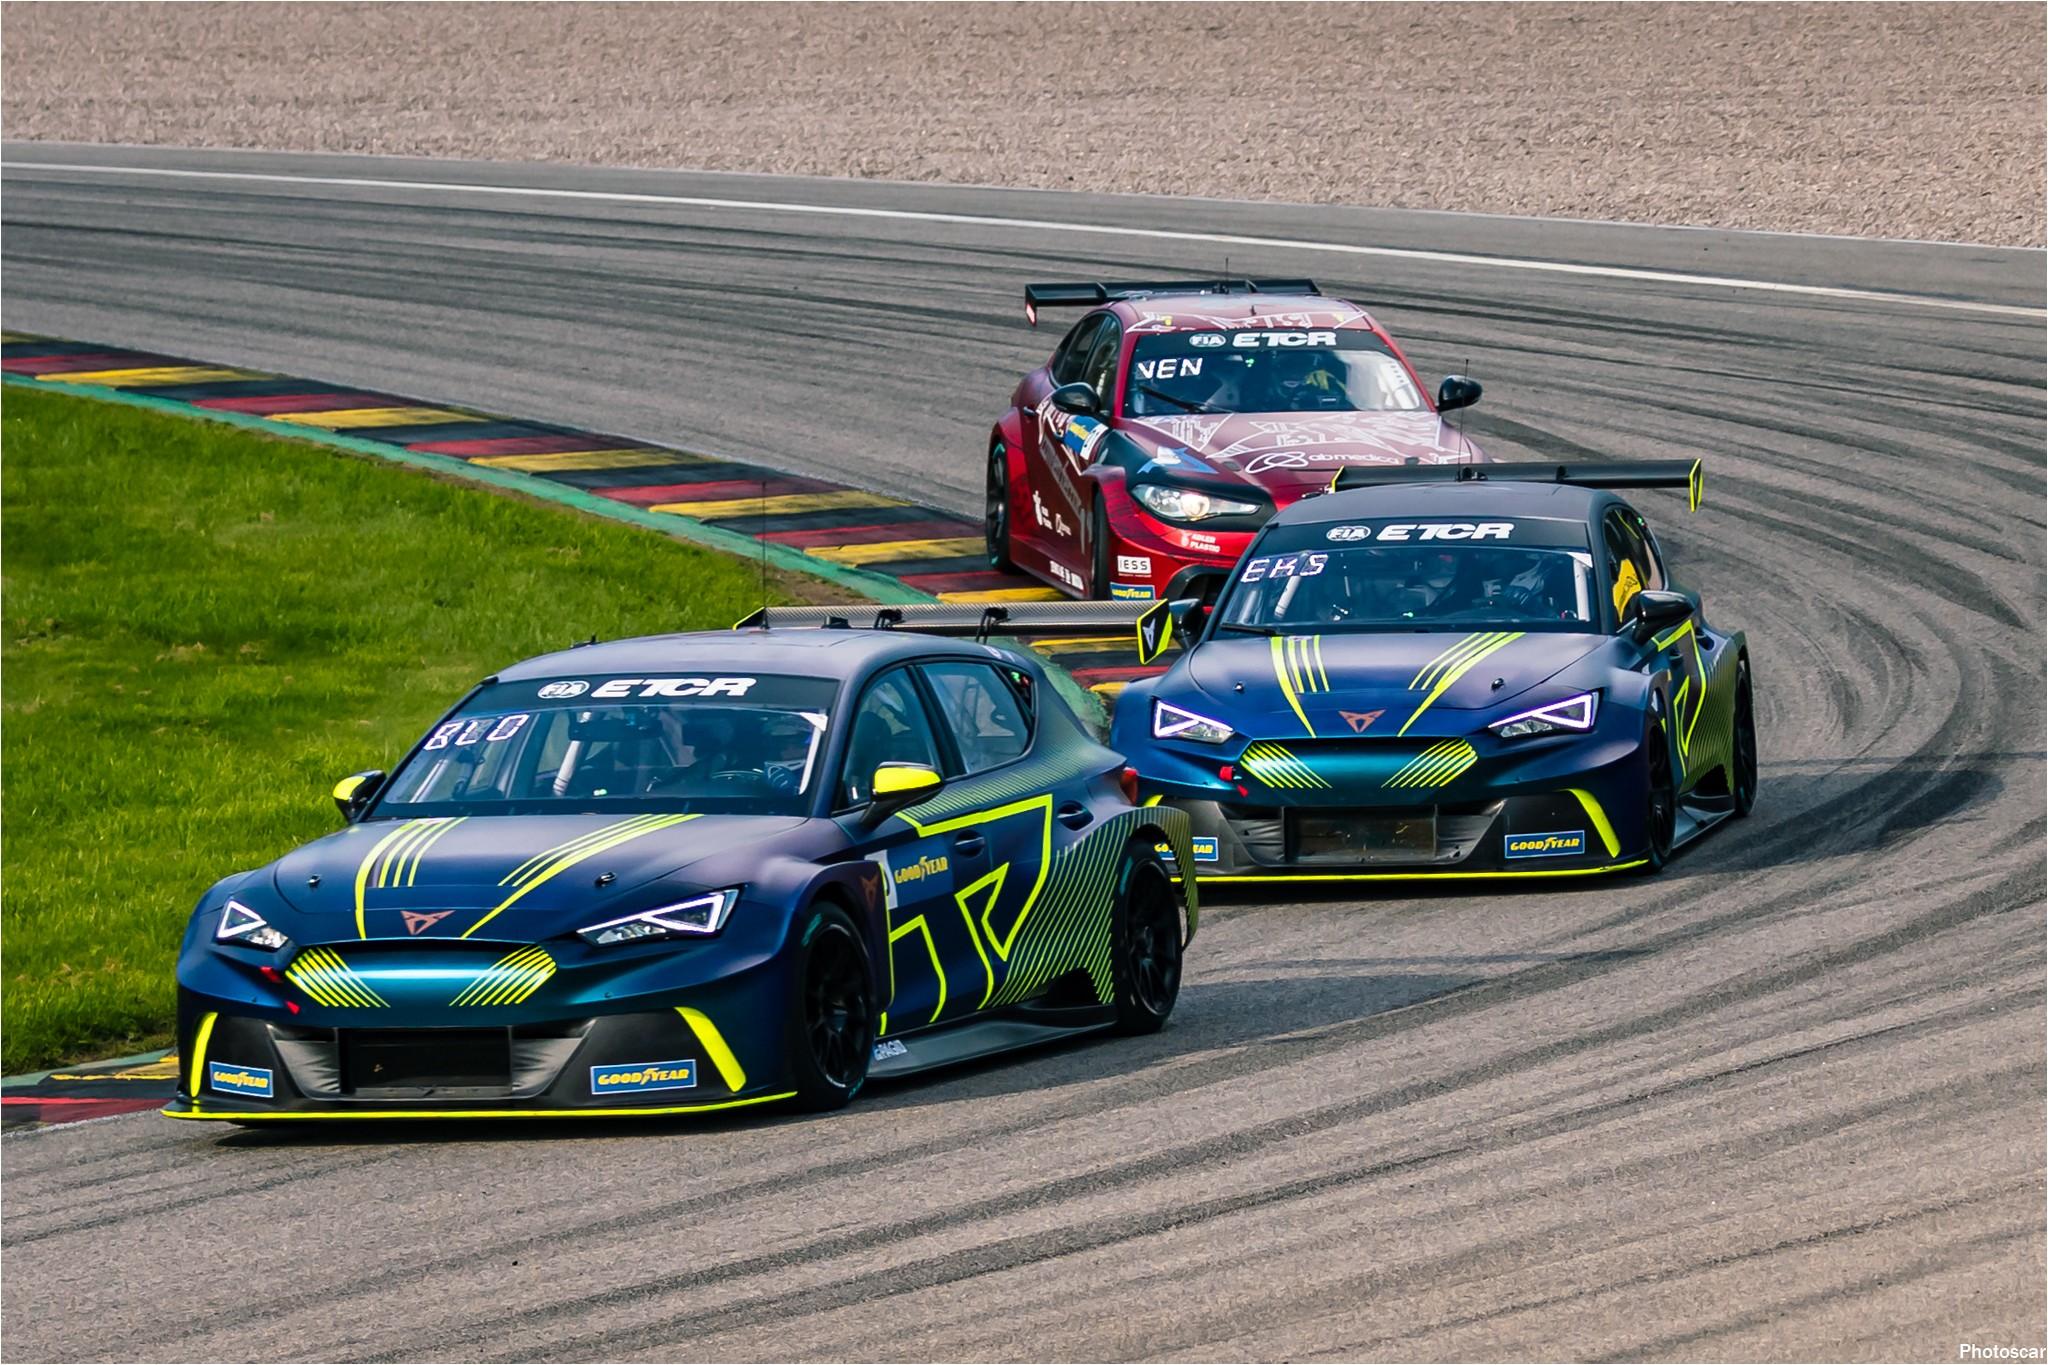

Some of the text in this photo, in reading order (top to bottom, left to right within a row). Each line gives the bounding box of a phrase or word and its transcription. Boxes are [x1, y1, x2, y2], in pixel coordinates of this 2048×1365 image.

[1190, 332, 1337, 347] FIA ETCR
[1137, 358, 1203, 379] VEN
[1328, 523, 1514, 541] FIA ETCR
[1239, 554, 1329, 583] EKS
[537, 678, 757, 698] FIA ETCR
[424, 714, 529, 750] BLO
[1510, 836, 1580, 851] GOODYEAR
[894, 856, 949, 884] GOODYEAR
[213, 1071, 269, 1088] GOODYEAR
[597, 1067, 690, 1086] GOODYEAR
